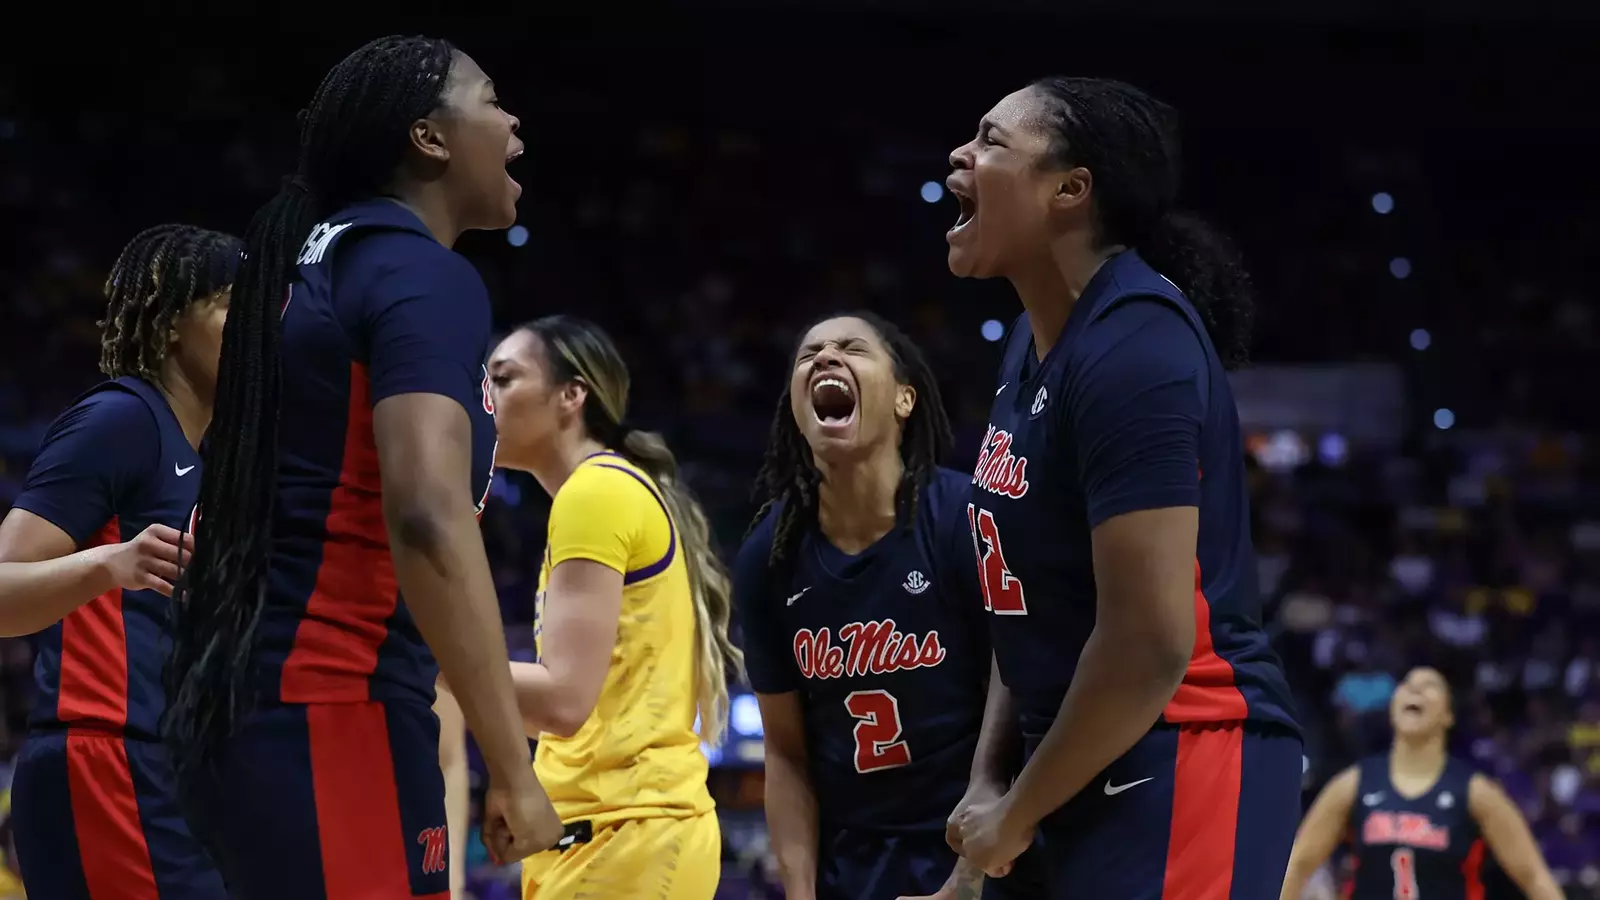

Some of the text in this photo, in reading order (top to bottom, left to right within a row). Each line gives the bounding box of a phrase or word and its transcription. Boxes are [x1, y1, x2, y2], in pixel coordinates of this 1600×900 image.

[907, 570, 924, 589] SEC
[967, 502, 1028, 616] 12
[794, 618, 946, 680] Ole Miss
[844, 689, 911, 774] 2
[418, 824, 447, 875] M
